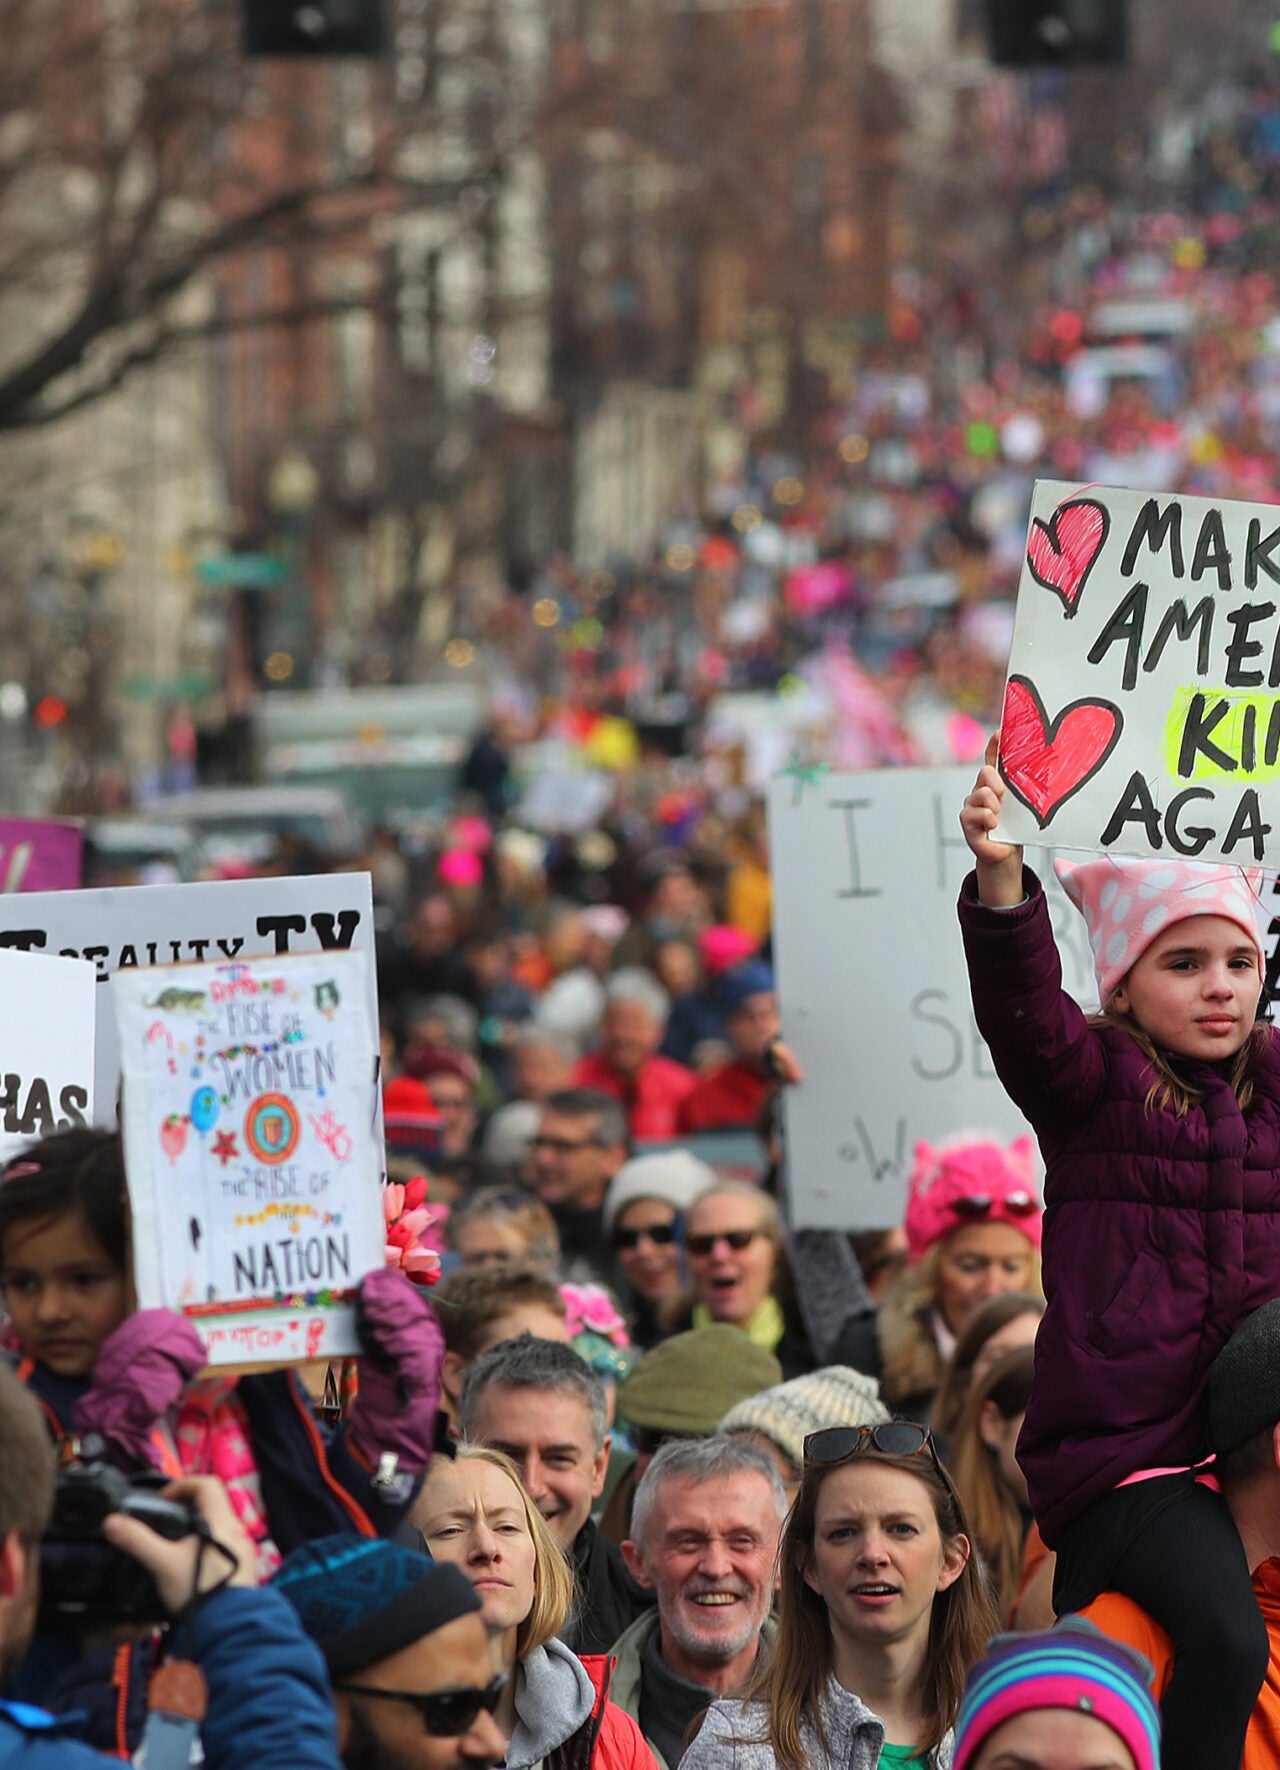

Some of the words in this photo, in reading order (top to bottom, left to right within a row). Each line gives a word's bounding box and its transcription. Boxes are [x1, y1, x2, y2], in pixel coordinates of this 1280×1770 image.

[207, 1041, 338, 1098] WOMEN
[254, 1166, 302, 1200] RISE
[233, 1233, 349, 1292] NATION
